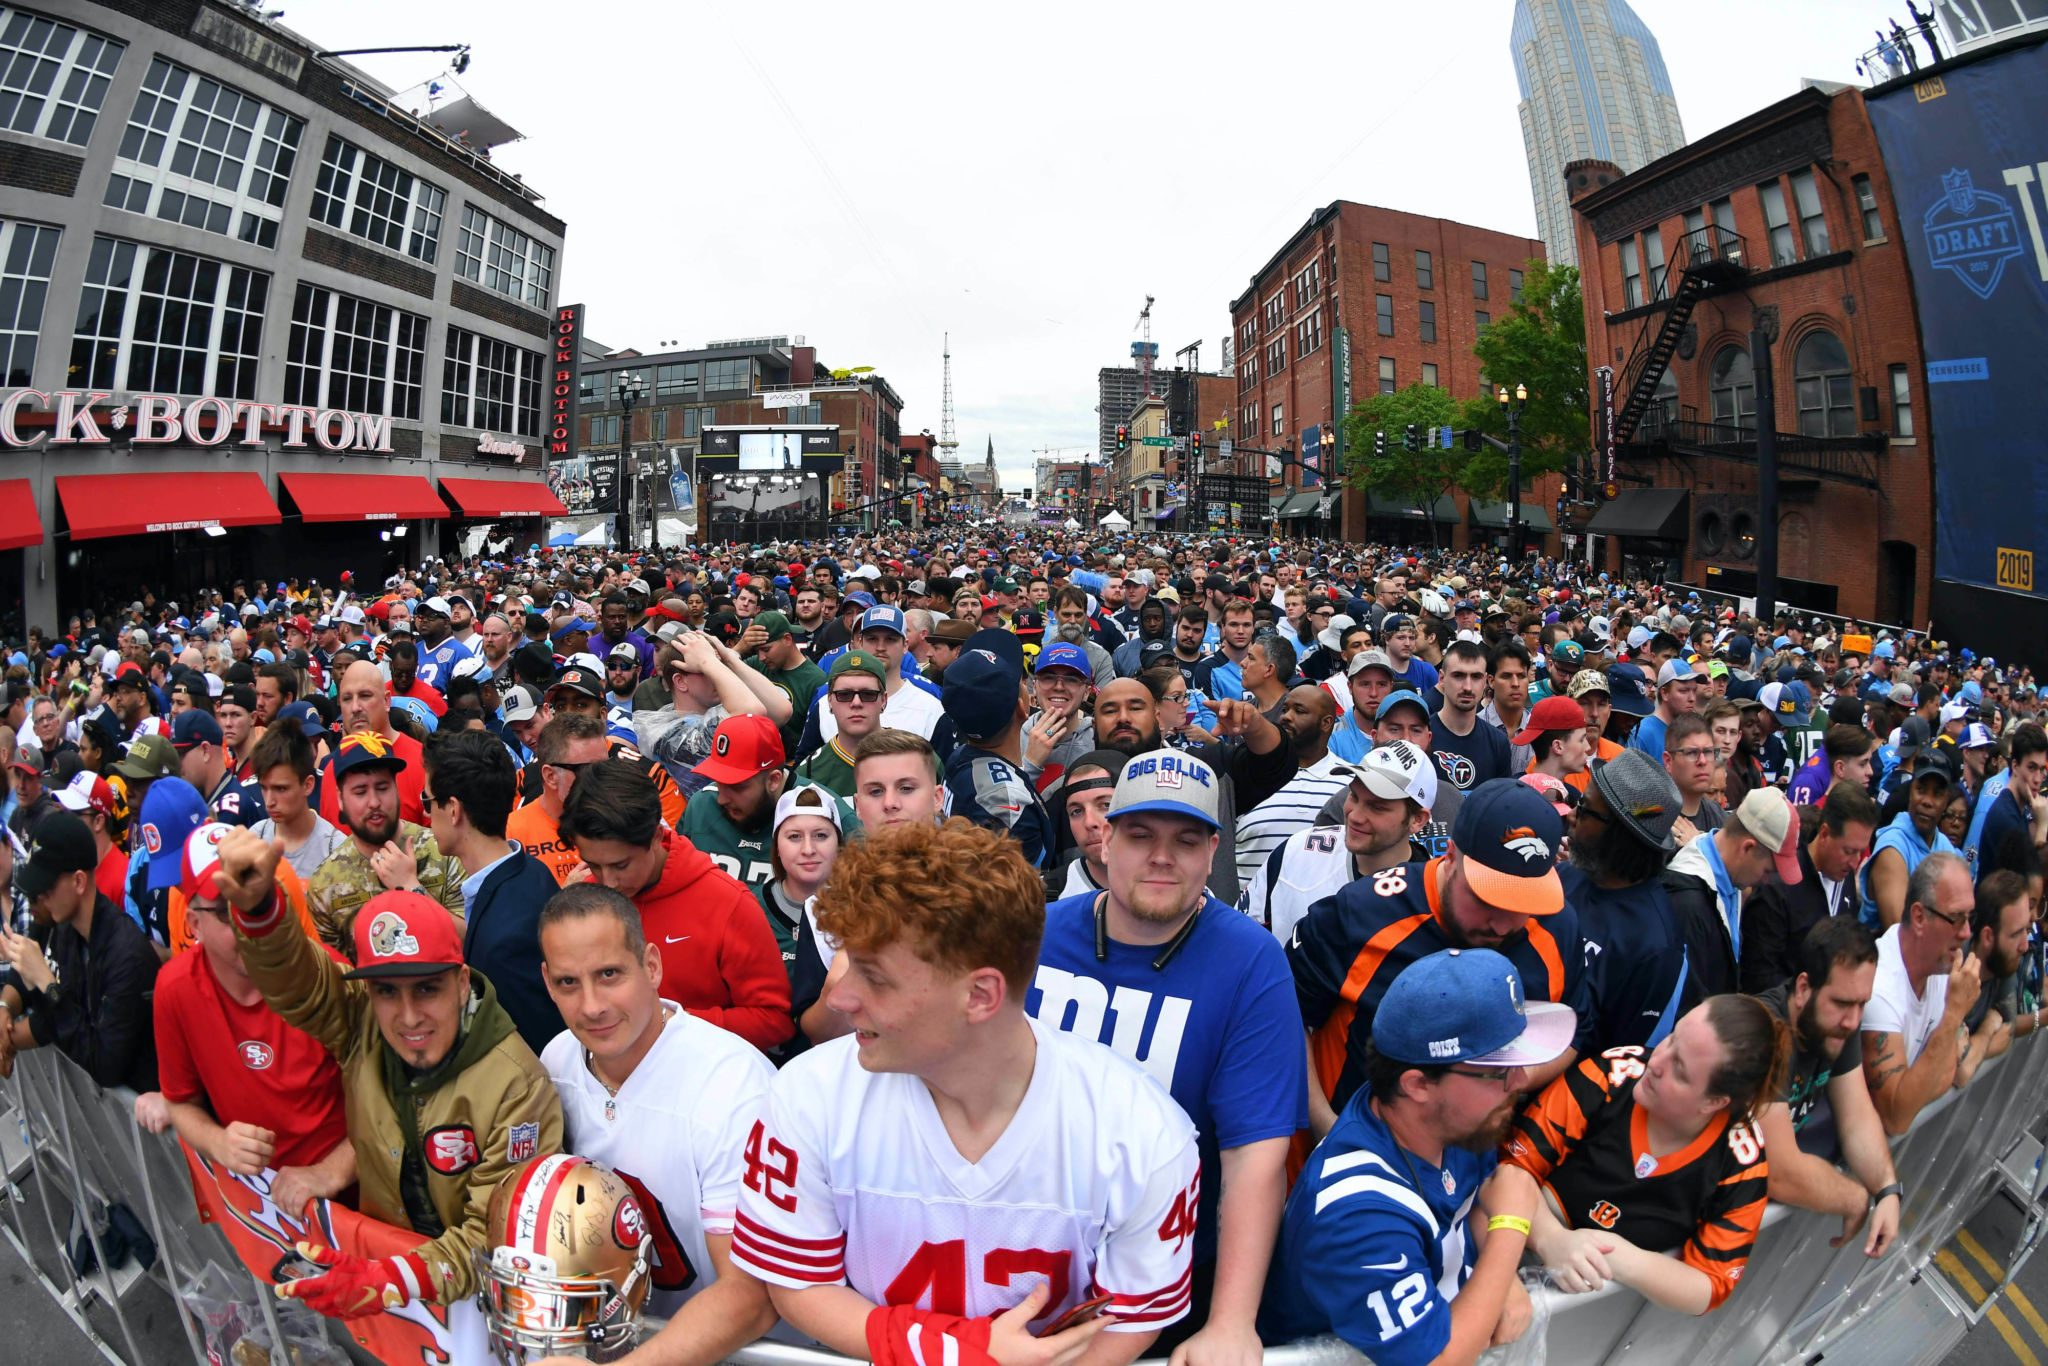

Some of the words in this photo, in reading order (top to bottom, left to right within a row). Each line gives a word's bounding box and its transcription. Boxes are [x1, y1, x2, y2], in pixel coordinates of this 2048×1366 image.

[1917, 76, 1945, 99] 2019
[1933, 221, 2010, 256] DRAFT
[556, 309, 574, 363] ROCK
[1930, 363, 1983, 376] TENNESSEE
[130, 393, 395, 453] BOTTOM
[551, 370, 571, 455] BOTTOM
[173, 522, 183, 530] ROCK
[2000, 551, 2030, 586] 2019
[987, 761, 1013, 784] 8
[1127, 758, 1157, 781] BIG
[1161, 756, 1210, 788] BLUE
[1793, 786, 1811, 807] 13
[737, 839, 762, 851] EAGLES
[1428, 1037, 1461, 1058] COLTS
[511, 1138, 535, 1160] NFL
[743, 1118, 799, 1214] 42
[1366, 1272, 1434, 1342] 12
